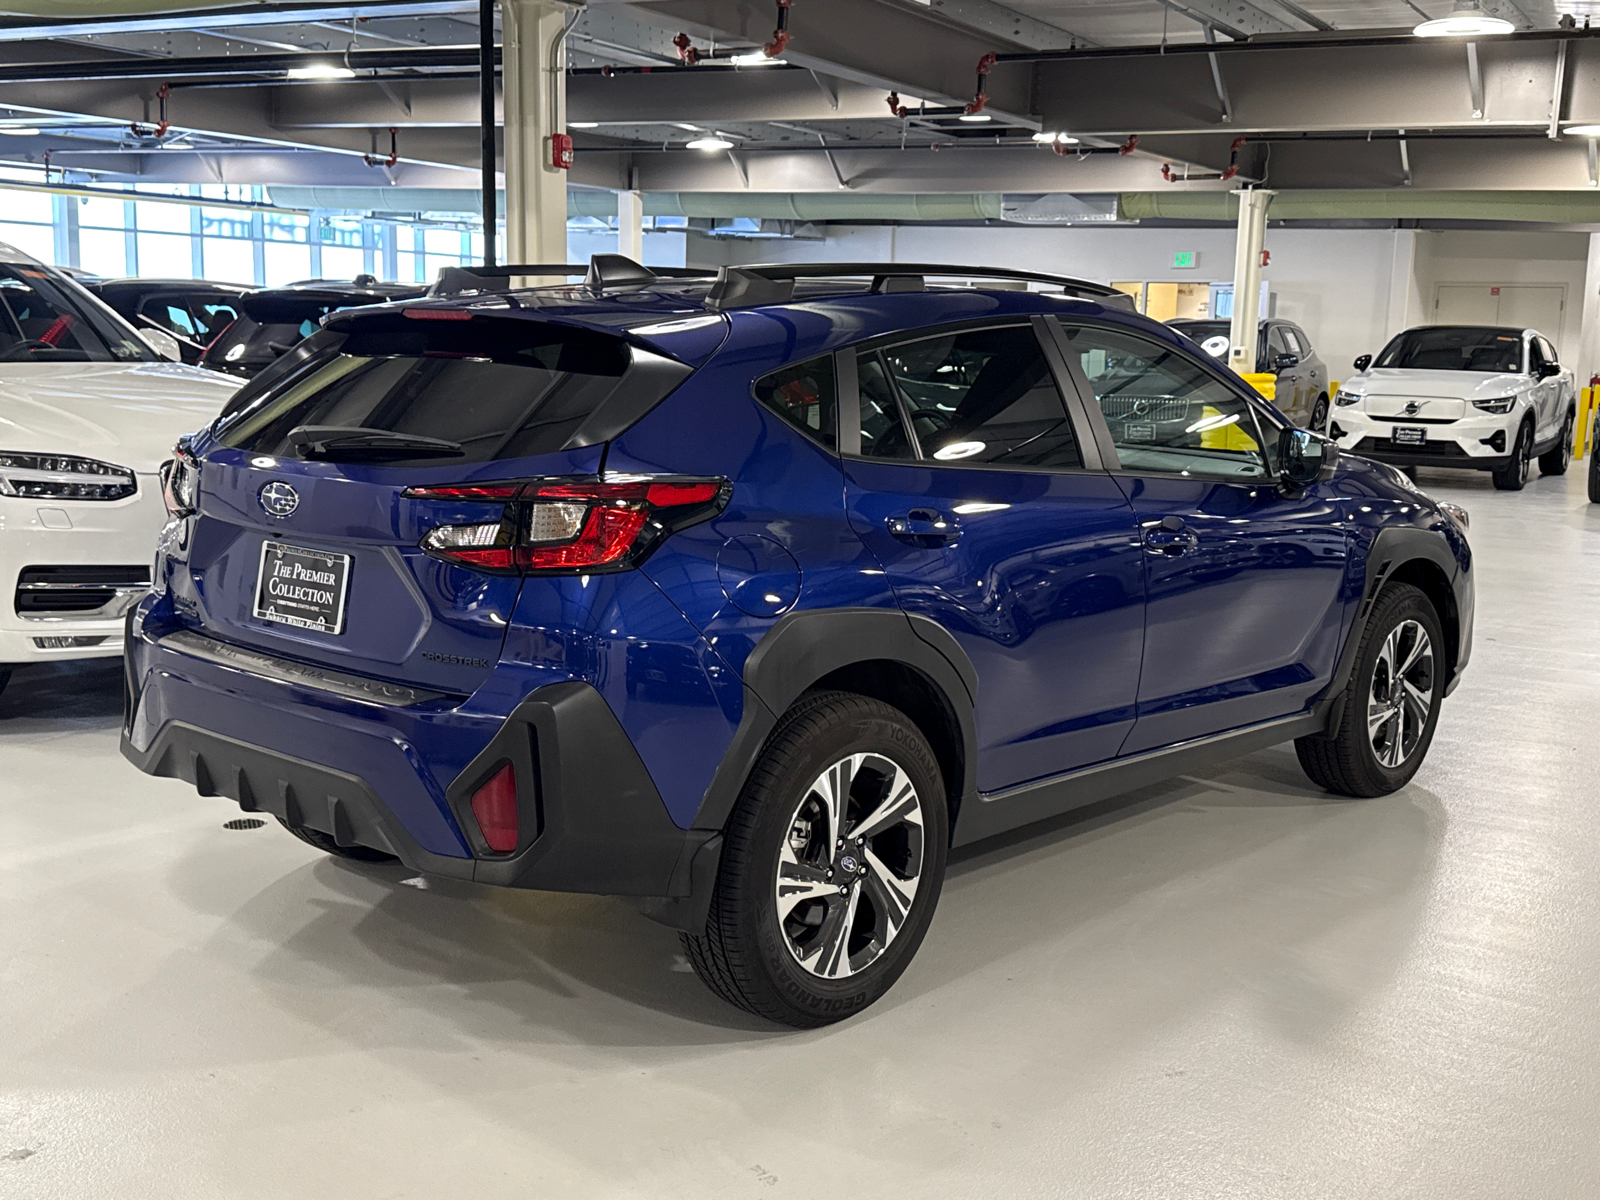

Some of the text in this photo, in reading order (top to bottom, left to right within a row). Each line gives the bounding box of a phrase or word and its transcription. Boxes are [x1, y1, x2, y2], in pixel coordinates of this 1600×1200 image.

[273, 559, 336, 586] THE PREMIER
[269, 577, 334, 605] COLLECTION
[421, 651, 489, 669] CROSSTREK
[889, 723, 938, 786] YOKOHAMA
